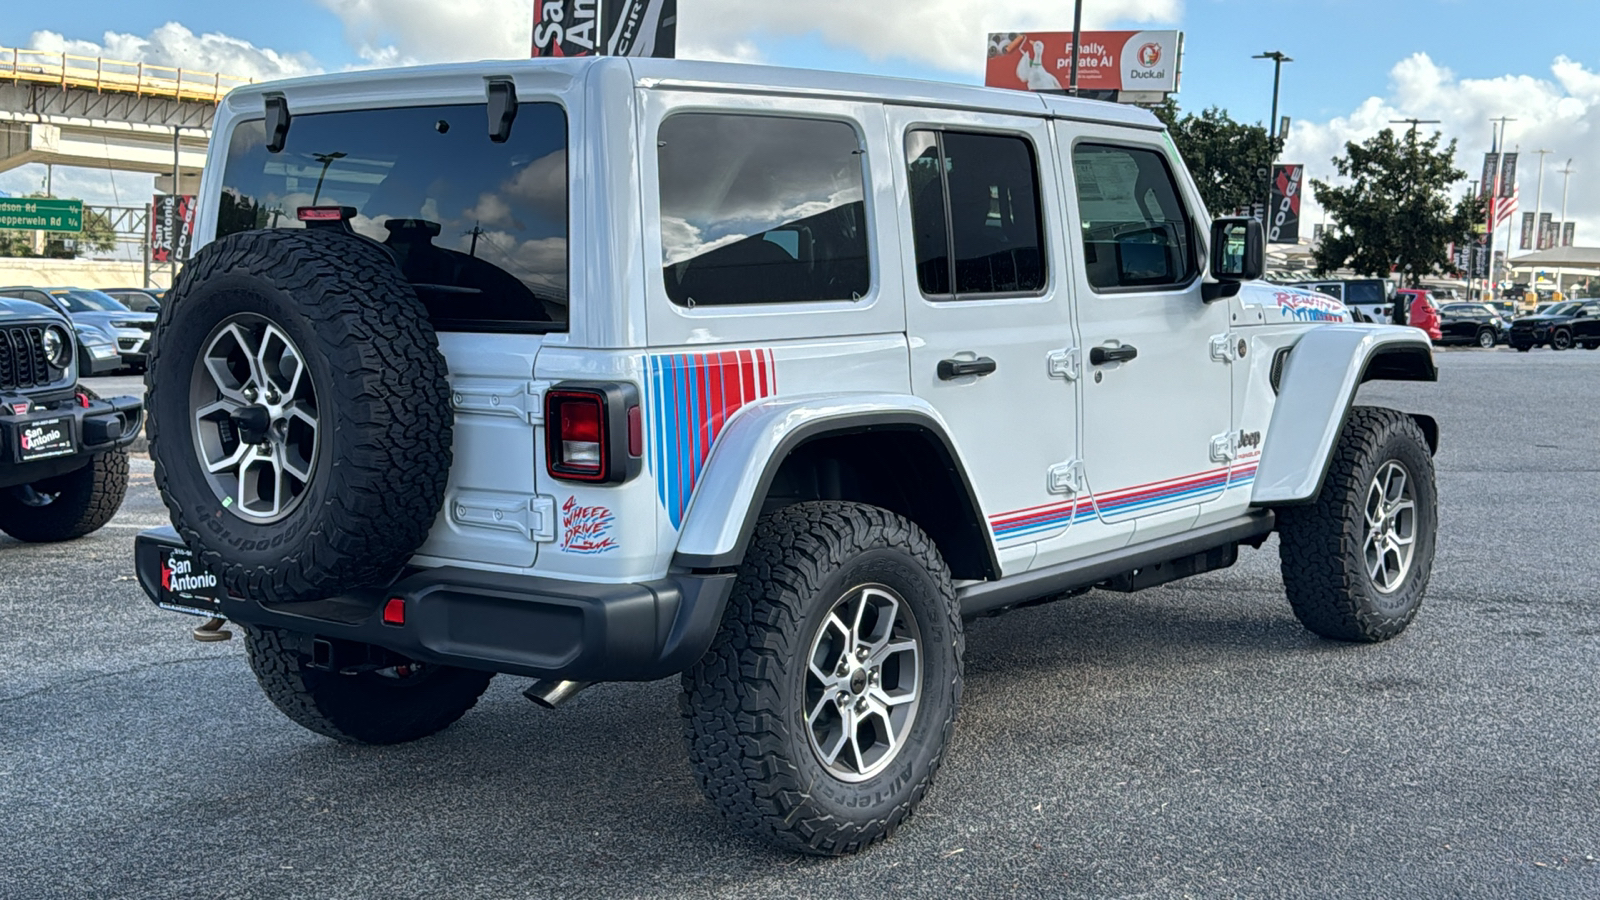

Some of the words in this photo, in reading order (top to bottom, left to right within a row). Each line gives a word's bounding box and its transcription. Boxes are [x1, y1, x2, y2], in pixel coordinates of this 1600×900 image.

[1065, 43, 1107, 56] Fnally,
[1057, 57, 1098, 70] priate
[1100, 56, 1113, 67] AI
[1130, 69, 1165, 79] Duck.ai
[25, 203, 37, 213] Rd
[1270, 167, 1302, 242] DODGE
[50, 216, 62, 226] Rd
[162, 197, 173, 250] Antonio
[175, 197, 197, 260] DODGE
[153, 224, 163, 249] San
[25, 427, 43, 439] San
[27, 429, 61, 450] Antonio
[1237, 429, 1261, 449] Jeep
[562, 495, 577, 513] 4
[563, 506, 612, 528] WHEEL
[564, 521, 608, 548] DRIVE
[168, 557, 192, 575] San
[169, 570, 217, 592] Antonio
